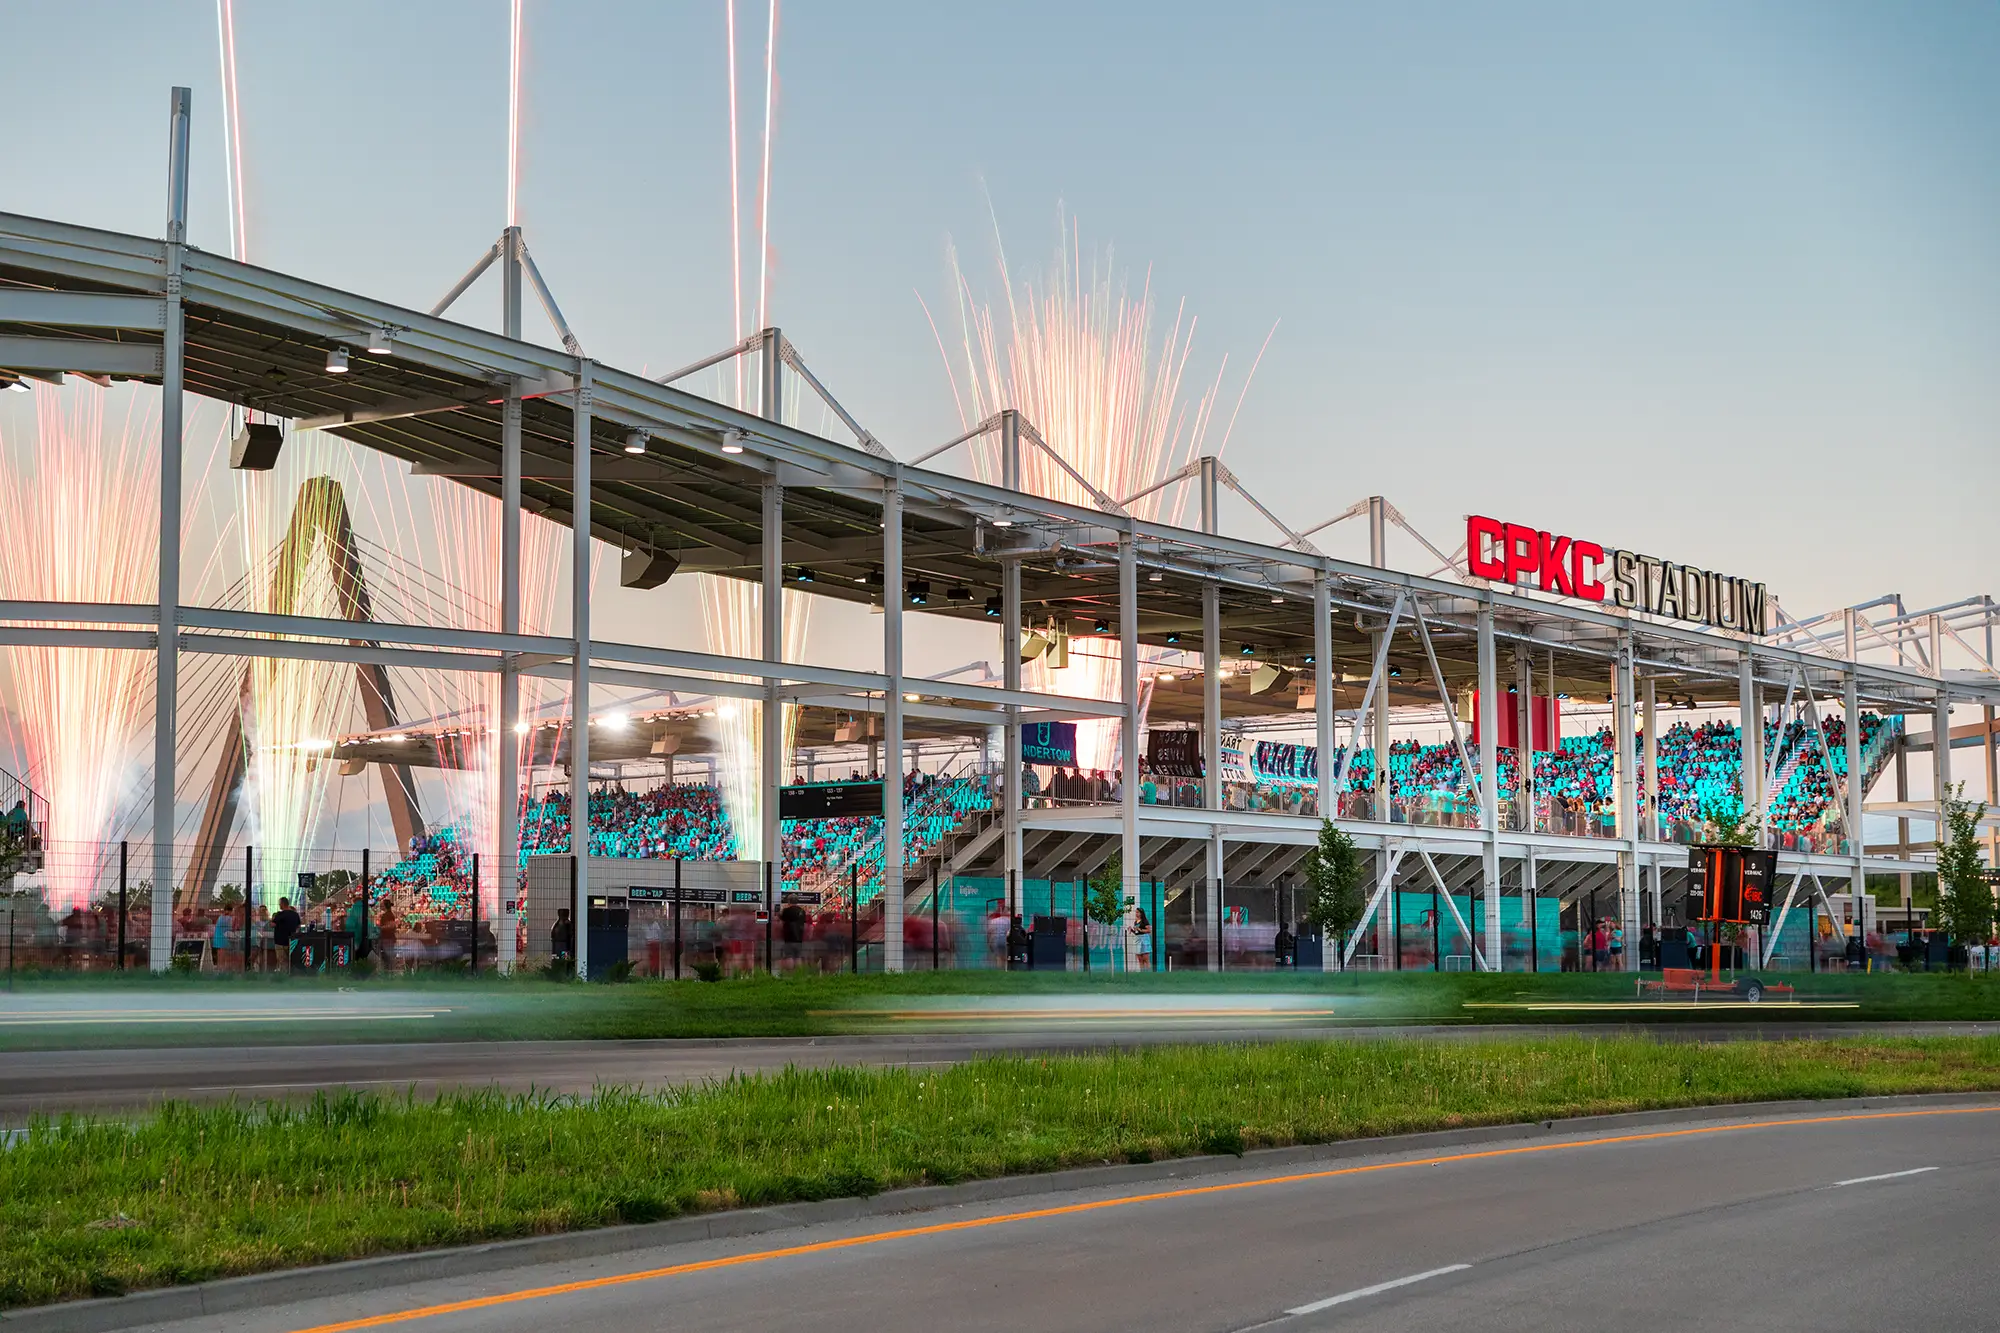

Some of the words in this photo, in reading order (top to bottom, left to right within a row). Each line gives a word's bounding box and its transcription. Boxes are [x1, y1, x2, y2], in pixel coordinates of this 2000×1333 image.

[1467, 515, 1605, 601] CPKC
[1613, 550, 1768, 637] STADIUM
[1023, 744, 1070, 761] NDERTOW
[631, 889, 647, 897] BEER
[652, 889, 663, 897] TAP
[735, 893, 752, 901] BEER
